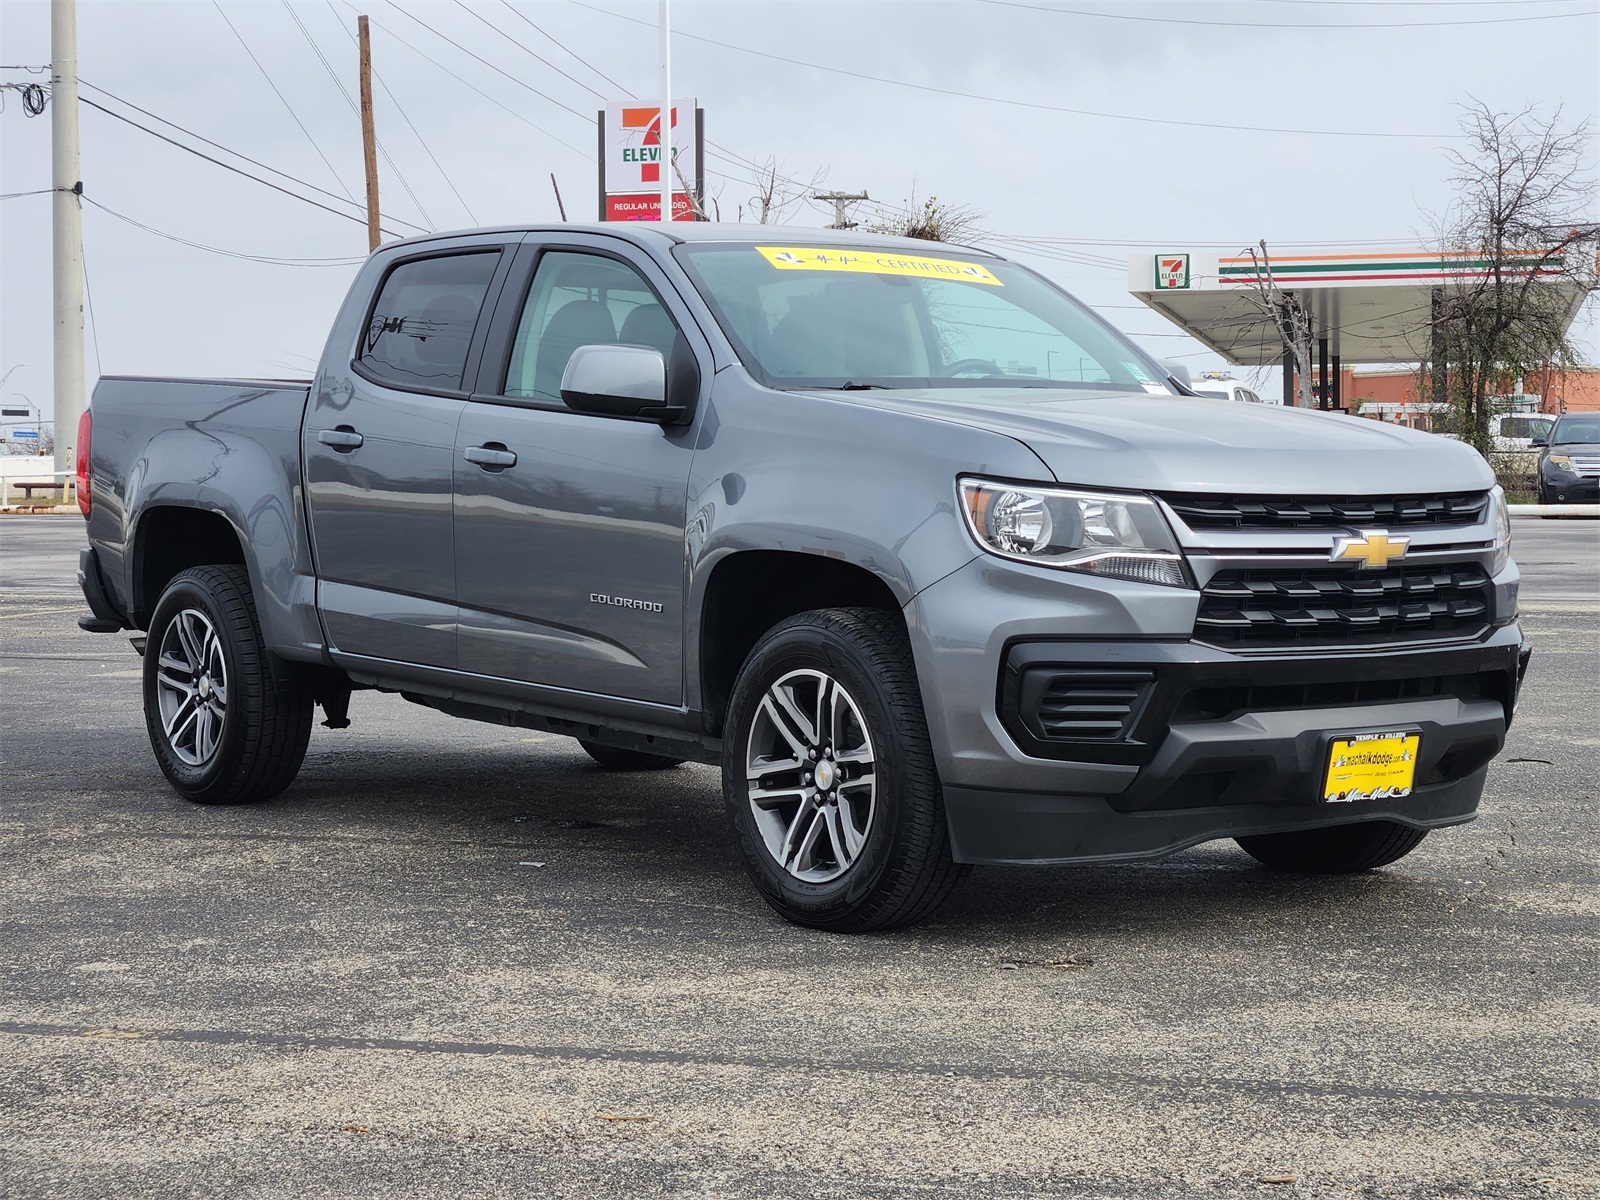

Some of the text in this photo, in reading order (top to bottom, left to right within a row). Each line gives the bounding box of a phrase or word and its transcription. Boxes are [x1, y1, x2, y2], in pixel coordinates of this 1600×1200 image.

[614, 202, 688, 211] REGULAR UNDED
[876, 258, 960, 275] CERTIFIED
[1162, 259, 1183, 287] 7
[589, 593, 663, 612] COLORADO
[1345, 788, 1367, 803] Mac
